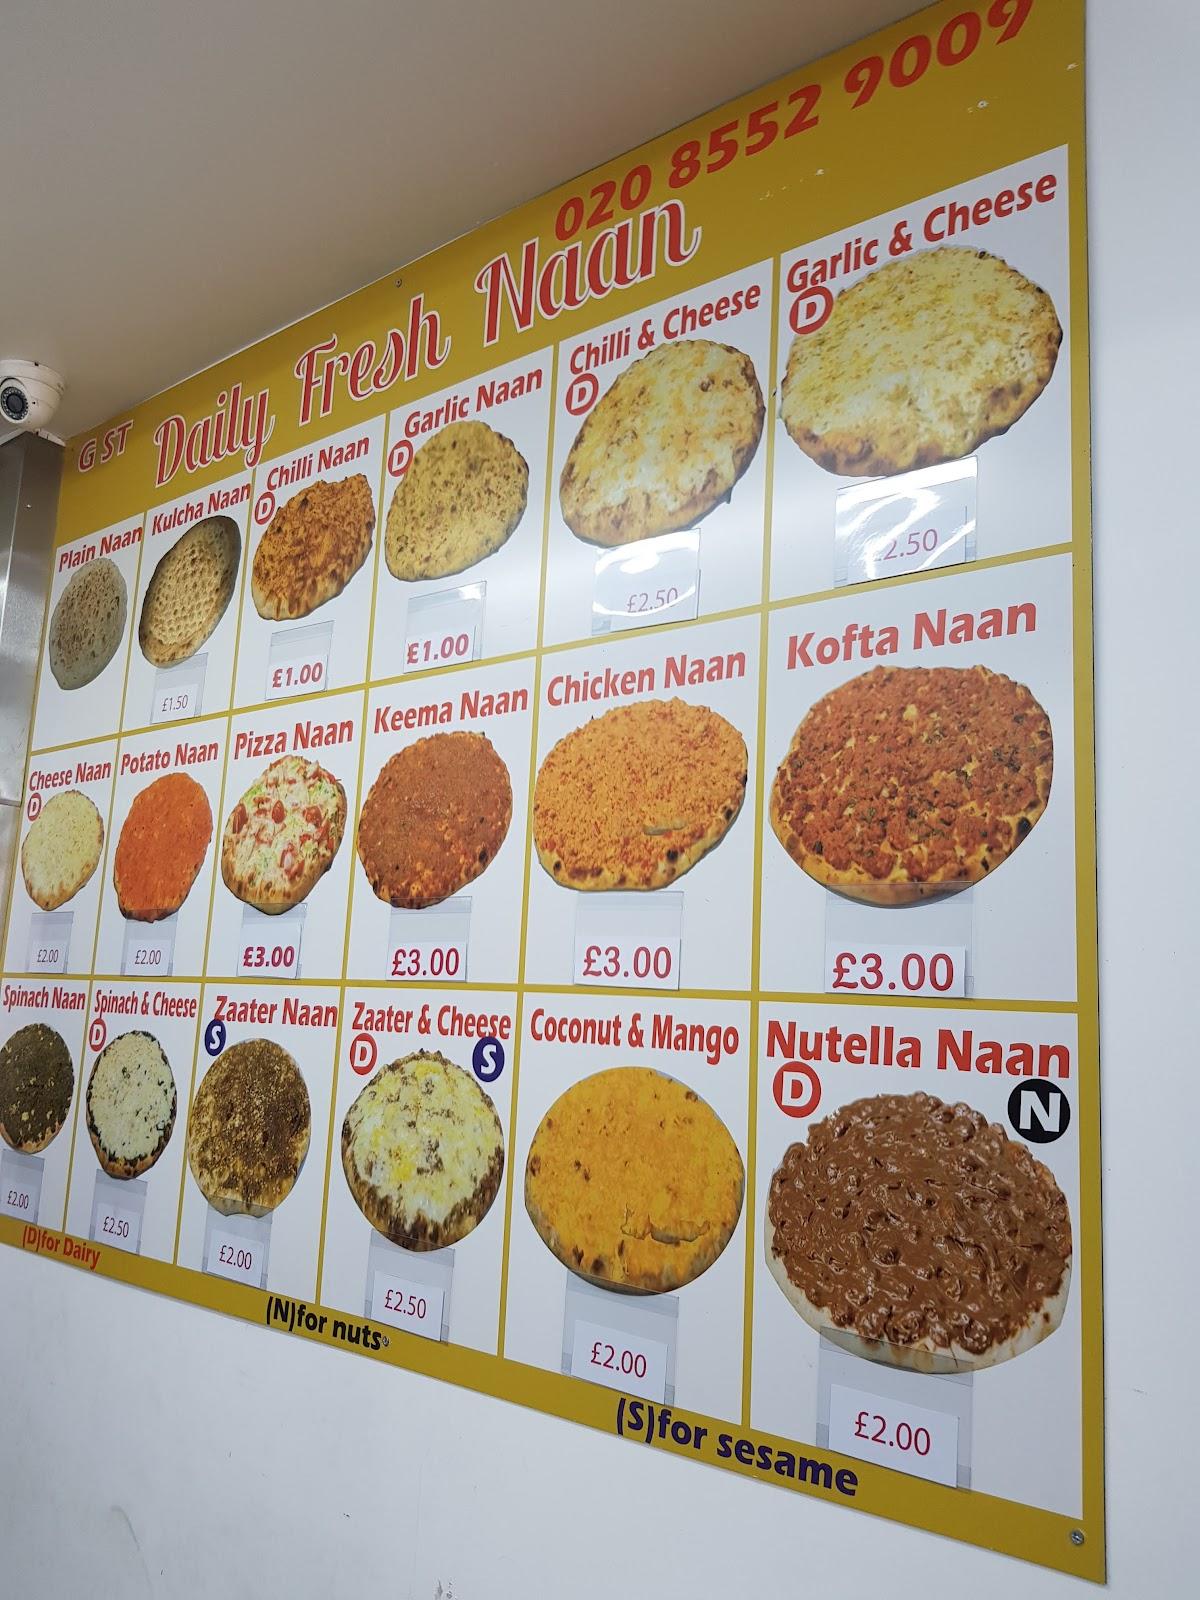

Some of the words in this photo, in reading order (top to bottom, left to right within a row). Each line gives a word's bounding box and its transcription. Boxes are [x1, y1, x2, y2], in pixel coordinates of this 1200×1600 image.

[554, 163, 651, 241] 020
[668, 84, 822, 188] 8552
[844, 0, 1033, 110] 9009
[786, 237, 878, 292] Garlic
[889, 221, 912, 256] &
[924, 174, 1057, 242] Cheese
[153, 383, 275, 487] Daily
[294, 293, 451, 427] Fresh
[474, 200, 702, 347] Naan
[569, 327, 630, 375] Chilli
[637, 324, 655, 351] &
[663, 284, 761, 339] Cheese
[404, 395, 469, 438] Garlic
[476, 367, 542, 408] Naan
[101, 420, 133, 463] ST
[267, 452, 312, 491] Chilli
[317, 436, 369, 473] Naan
[152, 500, 203, 537] Kulcha
[207, 482, 251, 511] Naan
[59, 544, 95, 573] Plain
[100, 525, 142, 554] Naan
[627, 587, 679, 613] £2.50
[407, 633, 469, 664] £1.00
[787, 622, 898, 670] Kofta
[912, 600, 1036, 650] Naan
[272, 661, 323, 688] £1.00
[547, 663, 655, 707] Chicken
[664, 651, 746, 689] Naan
[162, 693, 188, 712] £1.50
[374, 701, 453, 734] Keema
[460, 688, 528, 720] Naan
[234, 731, 287, 760] Pizza
[293, 720, 353, 749] Naan
[29, 768, 72, 792] Cheese
[76, 761, 111, 782] Naan
[120, 750, 170, 776] Potato
[174, 742, 218, 764] Naan
[37, 949, 59, 963] £2.00
[135, 950, 161, 965] £2.00
[243, 945, 294, 967] £3.00
[391, 947, 460, 976] £3.00
[583, 945, 671, 979] £3.00
[832, 952, 954, 991] £3.00
[3, 985, 48, 1012] Spinach
[51, 987, 86, 1010] Naan
[94, 990, 137, 1018] Spinach
[140, 991, 149, 1015] &
[152, 991, 197, 1017] Cheese
[214, 995, 277, 1023] Zaater
[282, 998, 337, 1027] Naan
[352, 1001, 412, 1033] Zaater
[417, 1004, 430, 1035] &
[436, 1004, 511, 1040] Cheese
[530, 1008, 621, 1047] Coconut
[628, 1013, 644, 1048] &
[652, 1014, 739, 1065] Mango
[766, 1020, 921, 1069] Nutella
[936, 1028, 1071, 1078] Naan
[7, 1190, 29, 1210] £2.00
[102, 1216, 129, 1238] £2.50
[63, 1237, 101, 1271] Dairy
[219, 1245, 252, 1270] £2.00
[384, 1289, 427, 1319] £2.50
[332, 1319, 381, 1350] nuts
[591, 1342, 647, 1378] £2.00
[854, 1410, 931, 1456] £2.00
[716, 1433, 858, 1496] sesame
